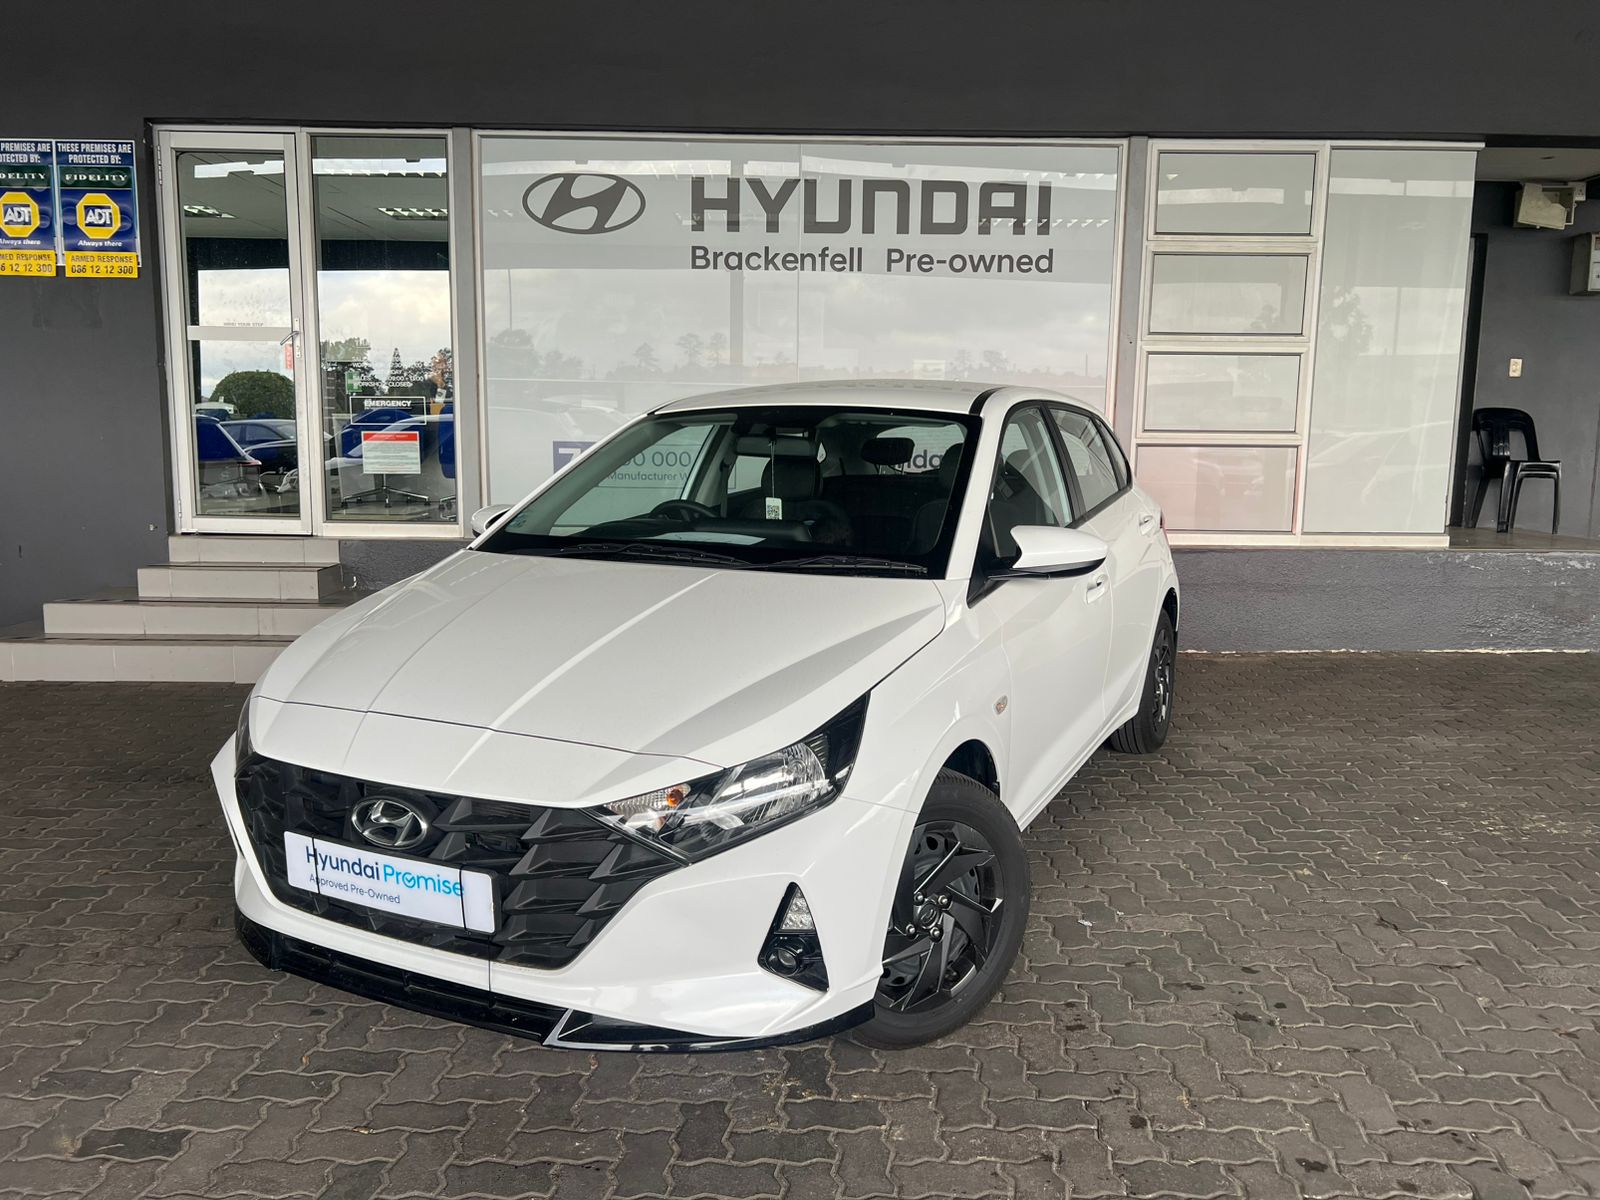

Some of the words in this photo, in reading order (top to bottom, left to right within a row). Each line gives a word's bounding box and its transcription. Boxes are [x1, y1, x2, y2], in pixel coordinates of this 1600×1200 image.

[0, 142, 36, 152] PREMISES
[37, 143, 51, 152] ARE
[57, 143, 79, 152] THESE
[80, 143, 117, 153] PREMISES
[118, 143, 132, 153] ARE
[30, 154, 41, 163] BY:
[68, 154, 109, 164] PROTECTED
[110, 154, 122, 164] BY:
[65, 173, 128, 182] FIDELITY
[691, 176, 1052, 236] HYUNDAI
[4, 207, 32, 223] ADT
[85, 208, 113, 225] ADT
[78, 240, 103, 248] Always
[16, 253, 51, 262] RESPONSE
[71, 255, 95, 263] ARMED
[97, 255, 134, 263] RESPONSE
[691, 245, 864, 273] Brackenfell
[886, 248, 1054, 274] Pre-owned
[9, 263, 20, 272] 12
[23, 263, 33, 272] 12
[36, 264, 53, 273] 300
[90, 265, 101, 274] 12
[104, 265, 115, 274] 12
[117, 266, 134, 275] 300
[608, 471, 678, 481] Manufacturer
[306, 846, 380, 881] Hyundai
[384, 864, 465, 897] Promise
[309, 873, 349, 893] Approved
[350, 883, 401, 904] Pre-Owned
